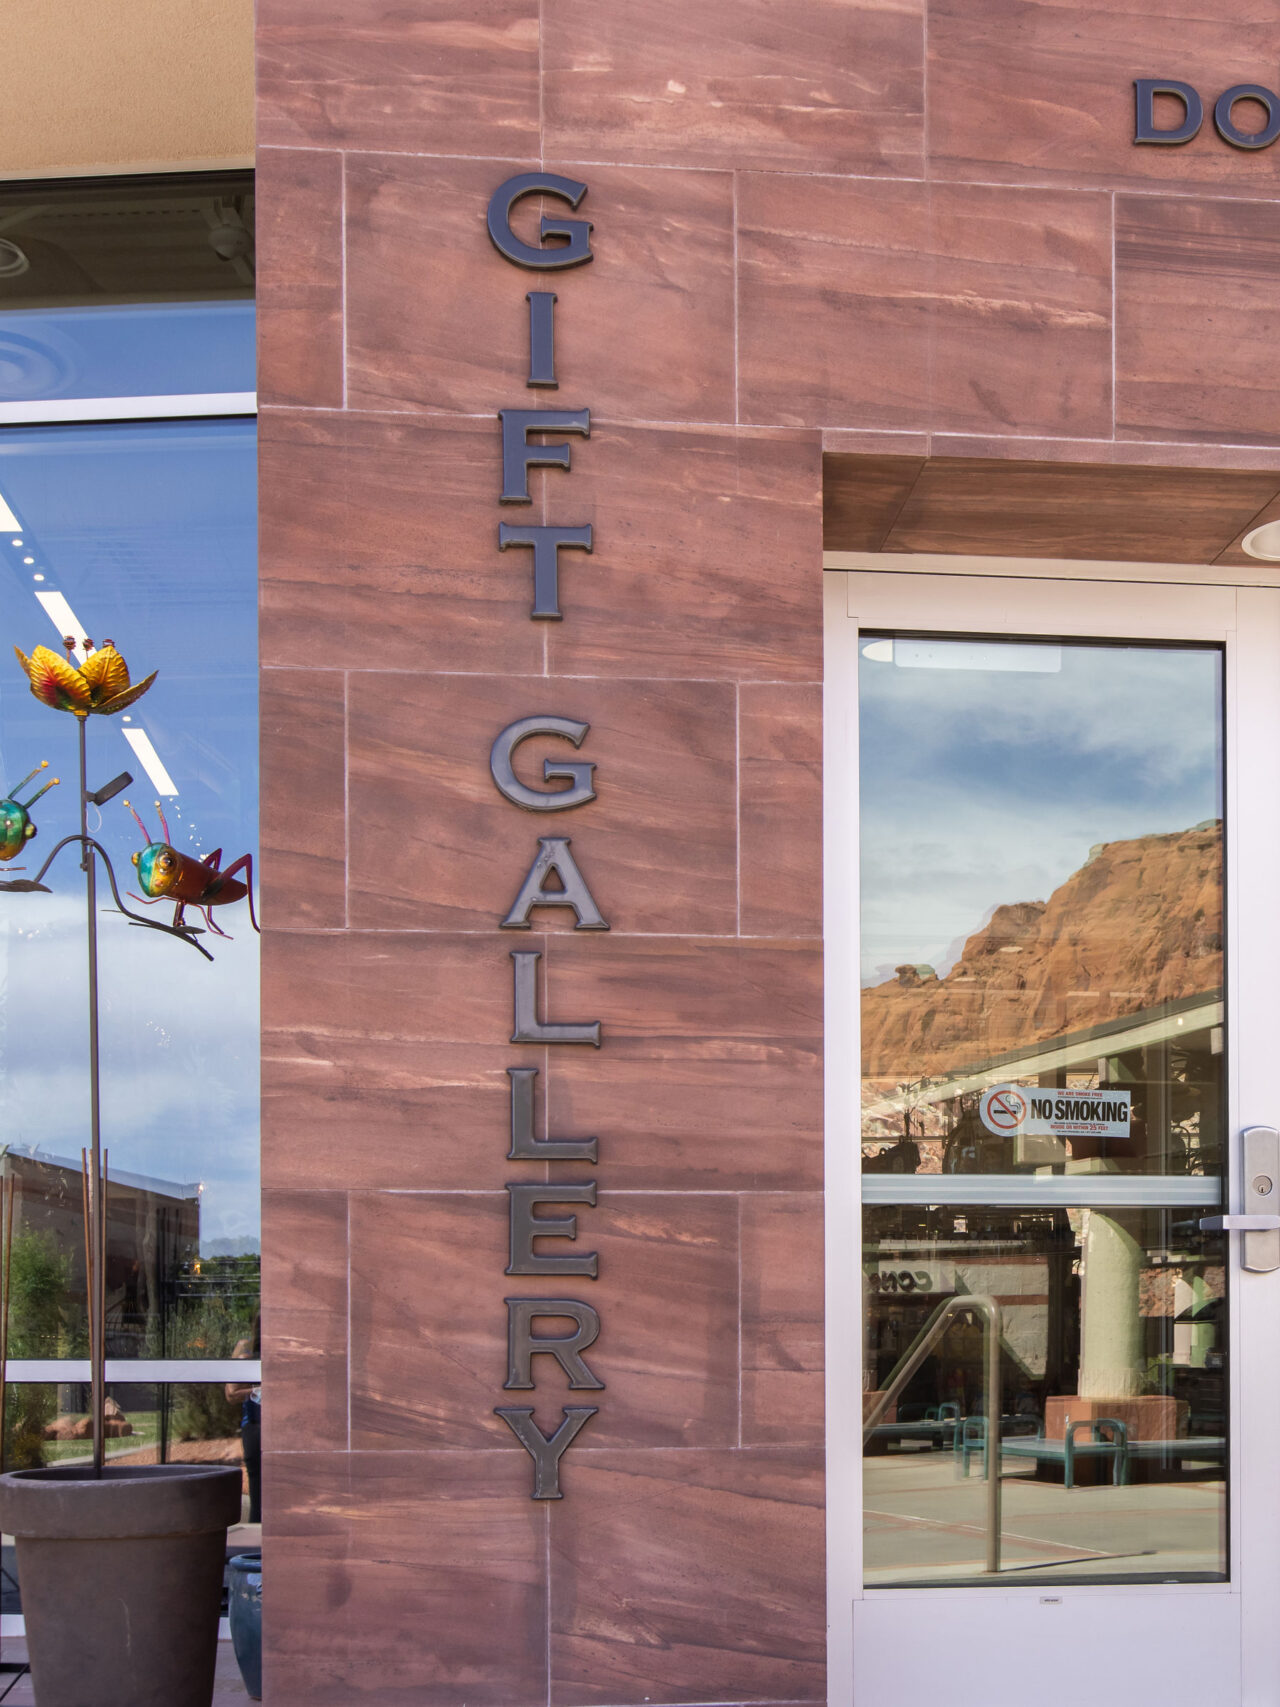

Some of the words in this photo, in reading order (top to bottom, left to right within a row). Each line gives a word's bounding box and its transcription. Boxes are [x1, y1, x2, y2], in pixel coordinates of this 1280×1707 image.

[486, 172, 594, 621] GIFT
[489, 714, 611, 1500] GALLERY
[1031, 1098, 1053, 1120] NO
[1054, 1099, 1128, 1122] SMOKING
